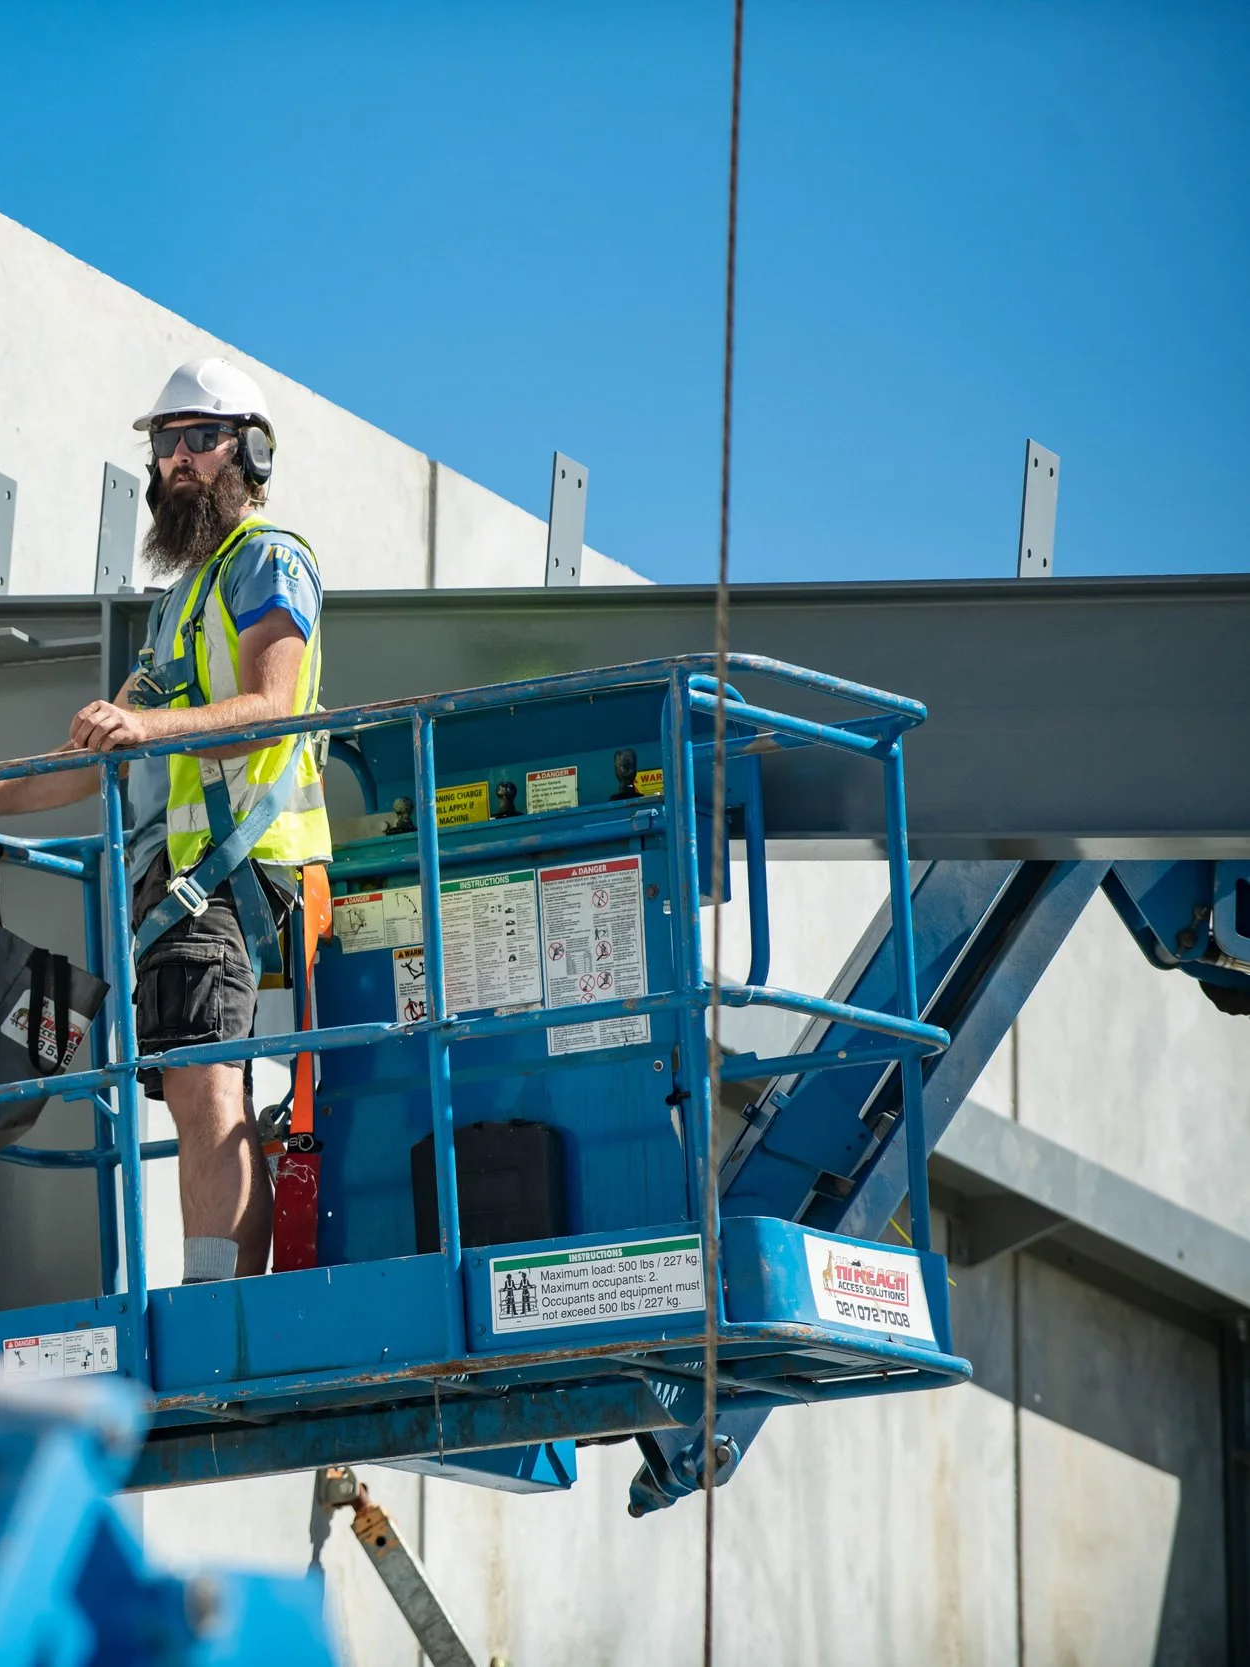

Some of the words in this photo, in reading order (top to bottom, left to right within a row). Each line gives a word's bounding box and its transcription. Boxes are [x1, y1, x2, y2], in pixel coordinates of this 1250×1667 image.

[541, 770, 569, 779] DANGER
[456, 789, 482, 800] CHARGE
[436, 806, 447, 814] ILL
[448, 803, 469, 812] APPLY
[470, 802, 475, 810] IF
[439, 814, 469, 825] MACHINE
[578, 864, 607, 875] DANGER
[460, 876, 510, 889] INSTRUCTIONS
[349, 895, 370, 904] DANGER
[568, 1248, 623, 1263] INSTRUCTIONS
[540, 1268, 588, 1281] Maximum
[591, 1264, 616, 1276] load:
[618, 1261, 637, 1272] 500
[640, 1259, 655, 1269] lbs
[657, 1258, 661, 1268] /
[664, 1256, 682, 1266] 227
[686, 1254, 700, 1266] kg.
[541, 1281, 589, 1294] Maximum
[592, 1274, 646, 1290] occupants:
[648, 1272, 658, 1282] 2.
[542, 1293, 594, 1309] Occupants
[598, 1289, 616, 1300] and
[620, 1282, 673, 1299] equipment
[676, 1281, 700, 1291] must
[838, 1281, 864, 1293] ACCESS
[866, 1286, 905, 1301] SOLUTIONS
[542, 1310, 558, 1320] not
[561, 1305, 596, 1318] exceed
[599, 1303, 618, 1314] 500
[620, 1300, 635, 1311] lbs
[638, 1300, 642, 1310] /
[645, 1297, 663, 1308] 227
[667, 1296, 681, 1307] kg.
[836, 1300, 857, 1319] 021
[858, 1306, 880, 1322] 072
[881, 1310, 910, 1327] 7008
[14, 1339, 36, 1348] DANGER
